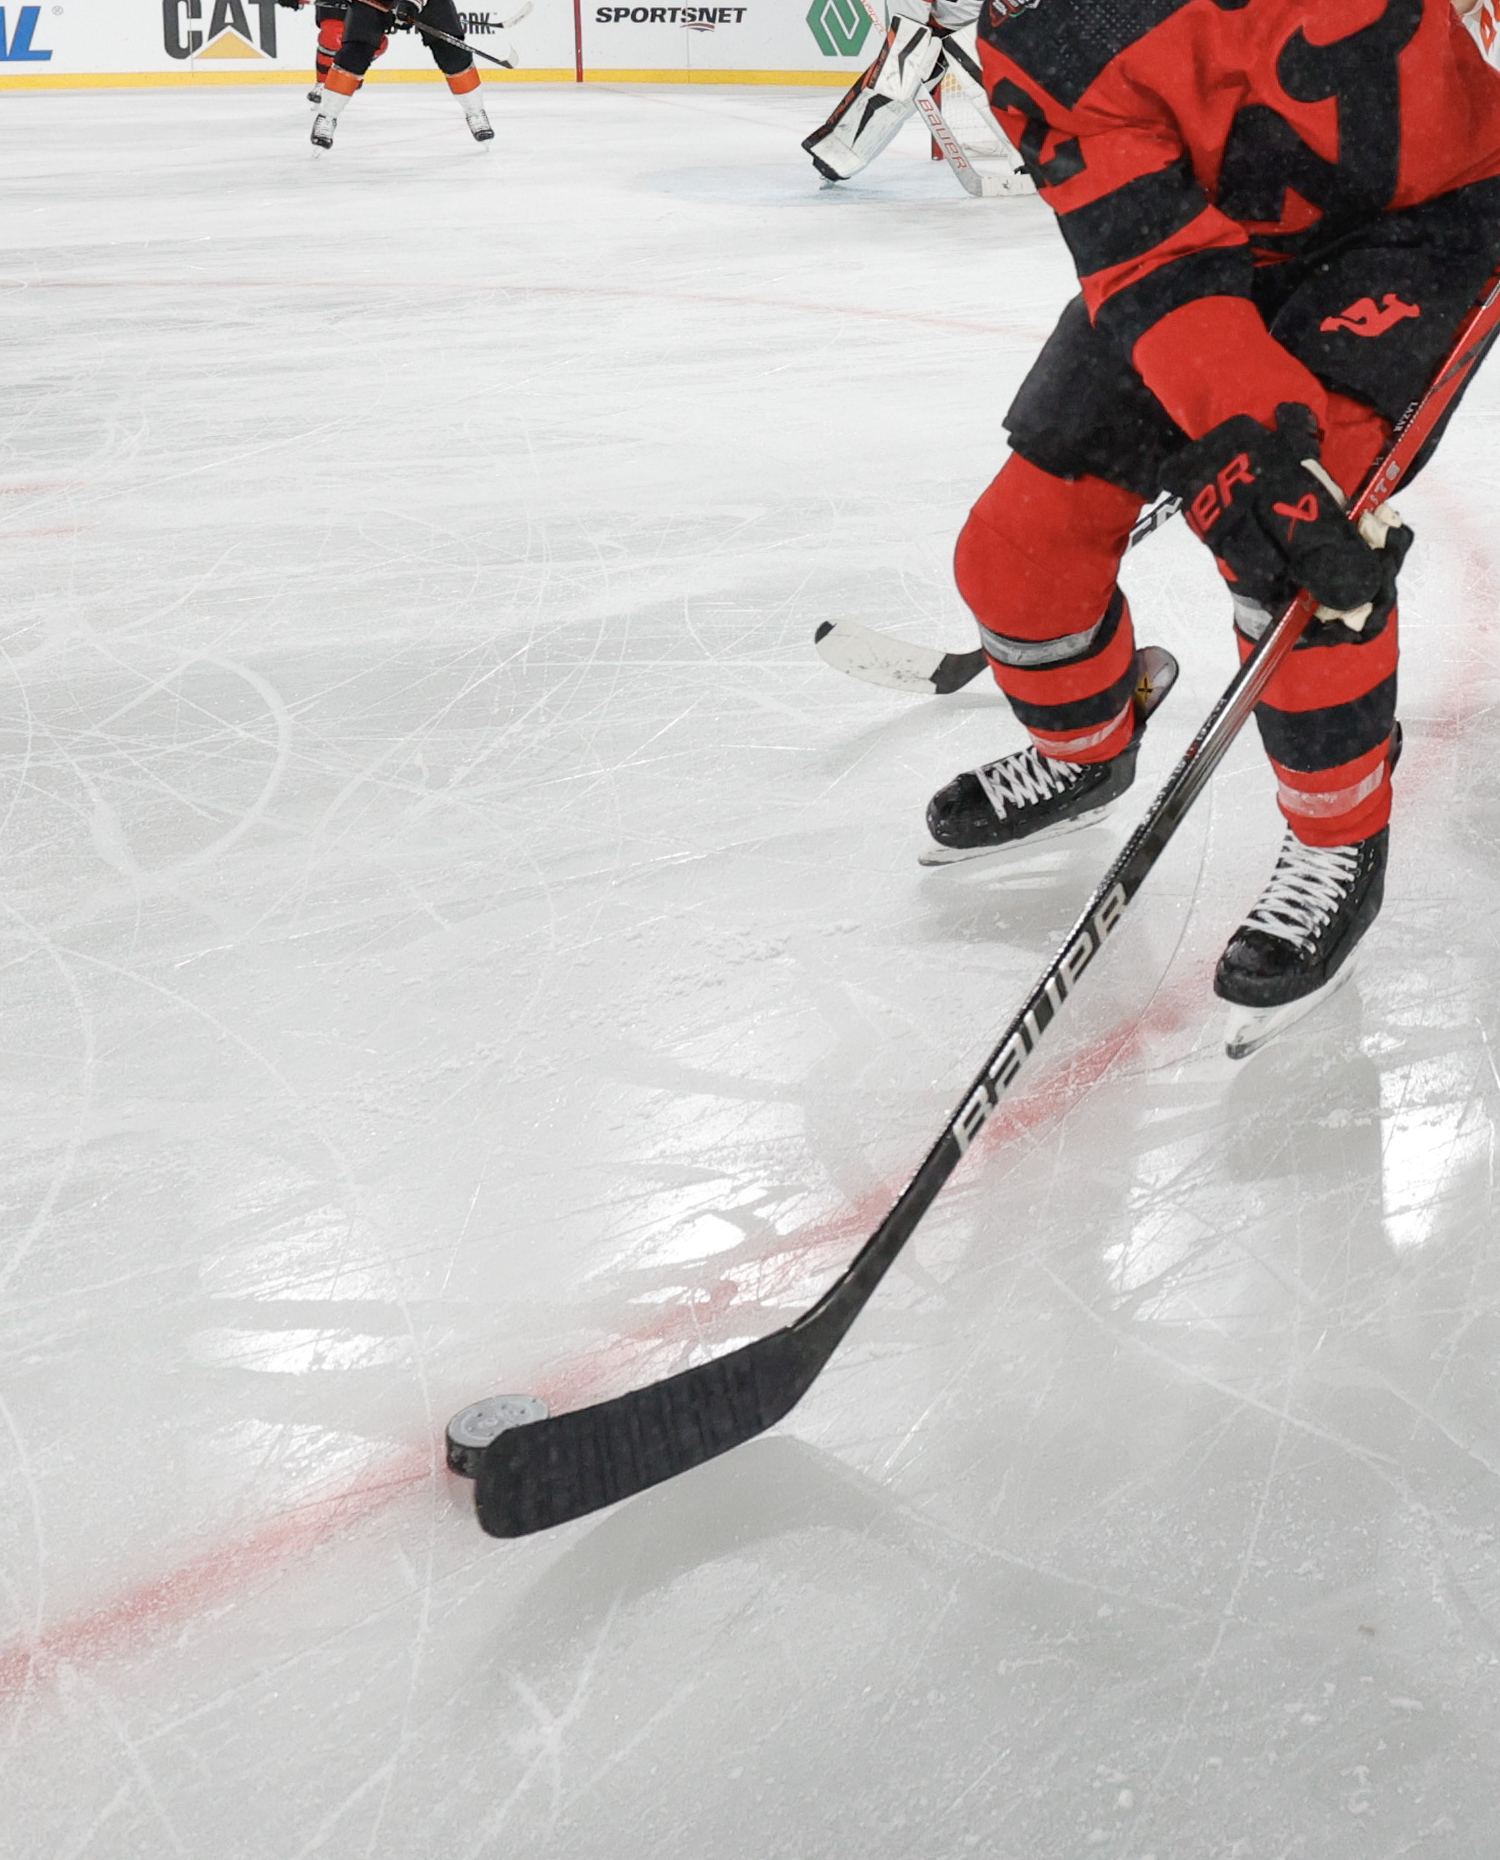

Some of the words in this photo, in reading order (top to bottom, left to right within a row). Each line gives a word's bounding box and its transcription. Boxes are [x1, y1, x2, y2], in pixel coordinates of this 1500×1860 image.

[595, 6, 748, 24] SPORTSNET
[918, 97, 968, 170] BAUER
[950, 880, 1131, 1158] BAUER
